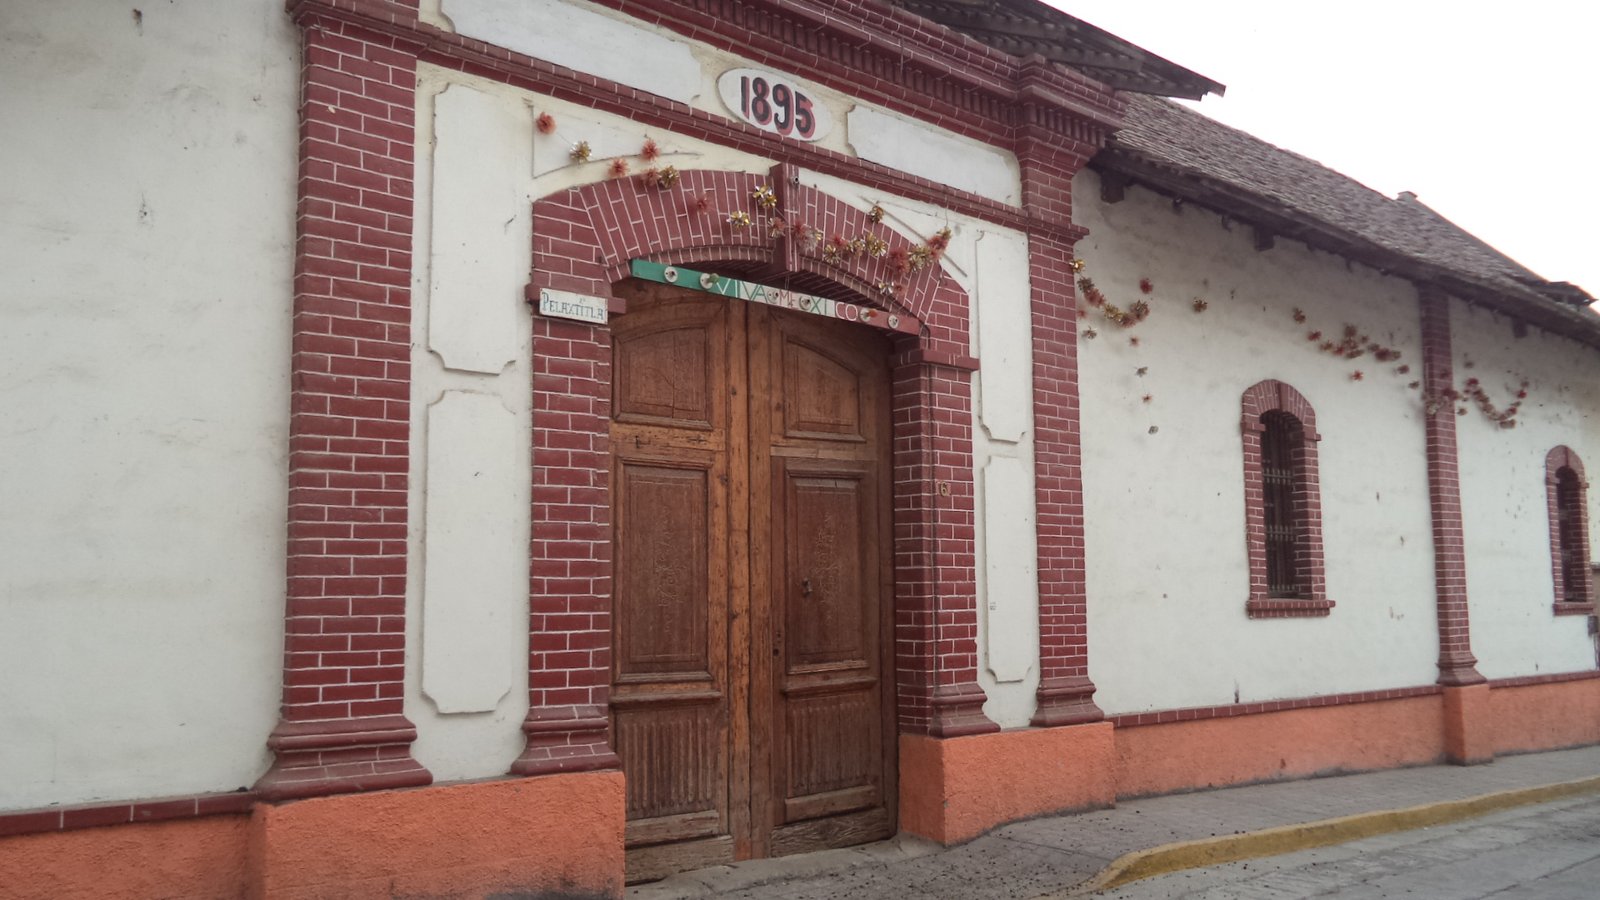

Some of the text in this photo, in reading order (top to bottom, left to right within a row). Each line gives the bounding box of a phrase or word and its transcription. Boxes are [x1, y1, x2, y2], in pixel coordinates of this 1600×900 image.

[741, 76, 816, 139] 1895
[716, 278, 858, 321] VIVA MEXICO
